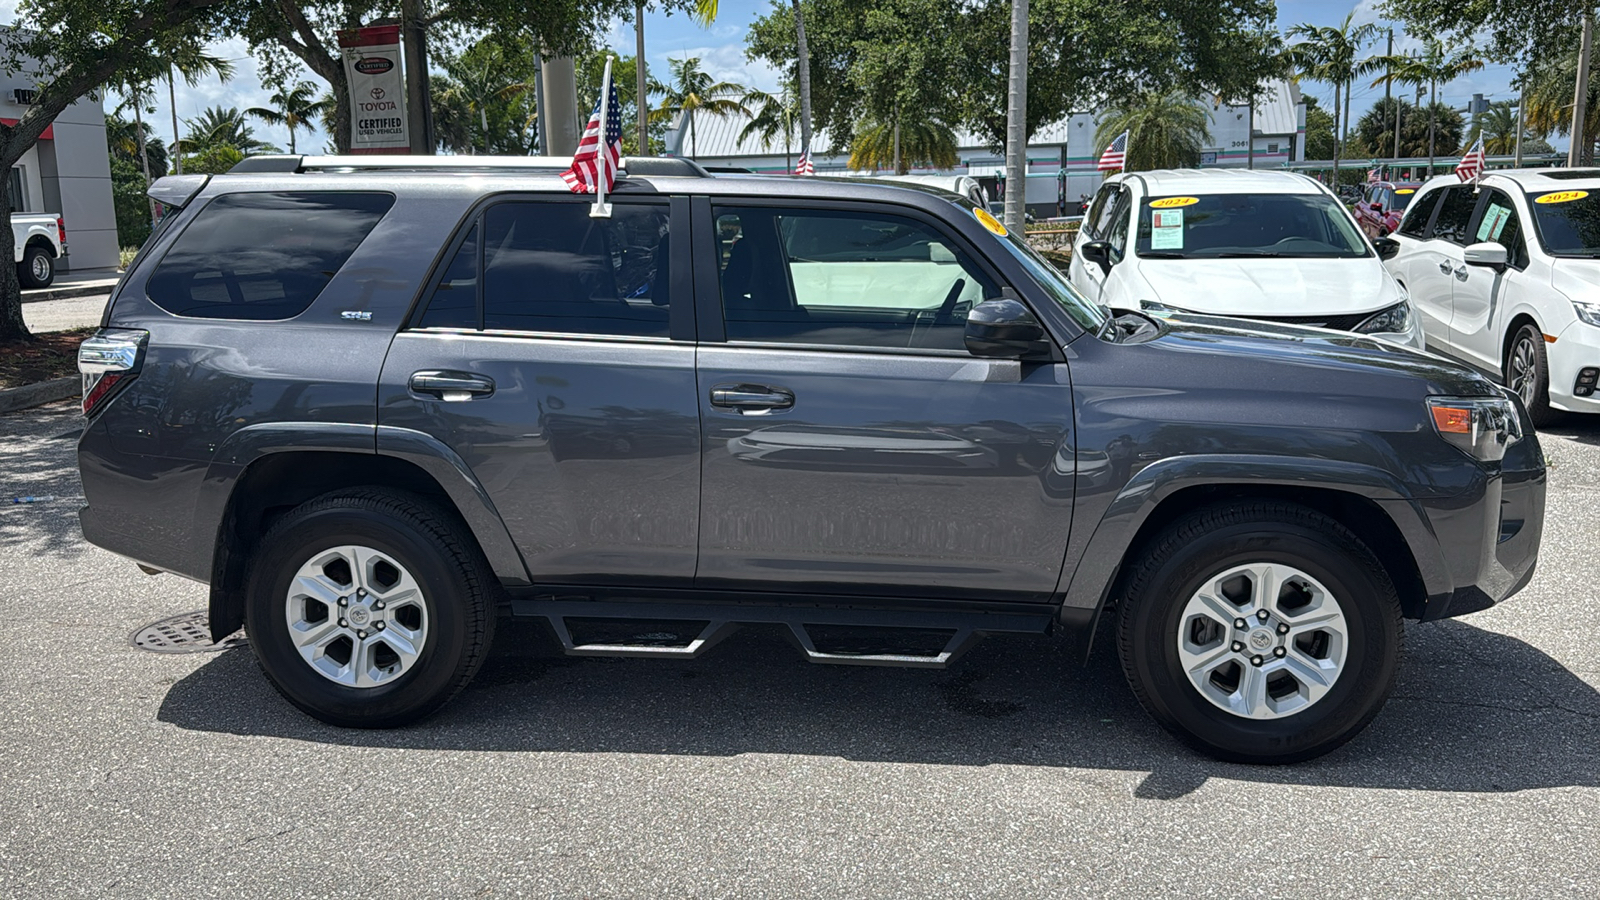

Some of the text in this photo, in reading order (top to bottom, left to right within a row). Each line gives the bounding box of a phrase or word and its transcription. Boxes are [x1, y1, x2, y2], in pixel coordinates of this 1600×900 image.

[359, 101, 397, 111] TOYOTA
[359, 118, 401, 129] CERTIFIED
[1156, 198, 1190, 206] 2024
[1545, 192, 1579, 202] 2024
